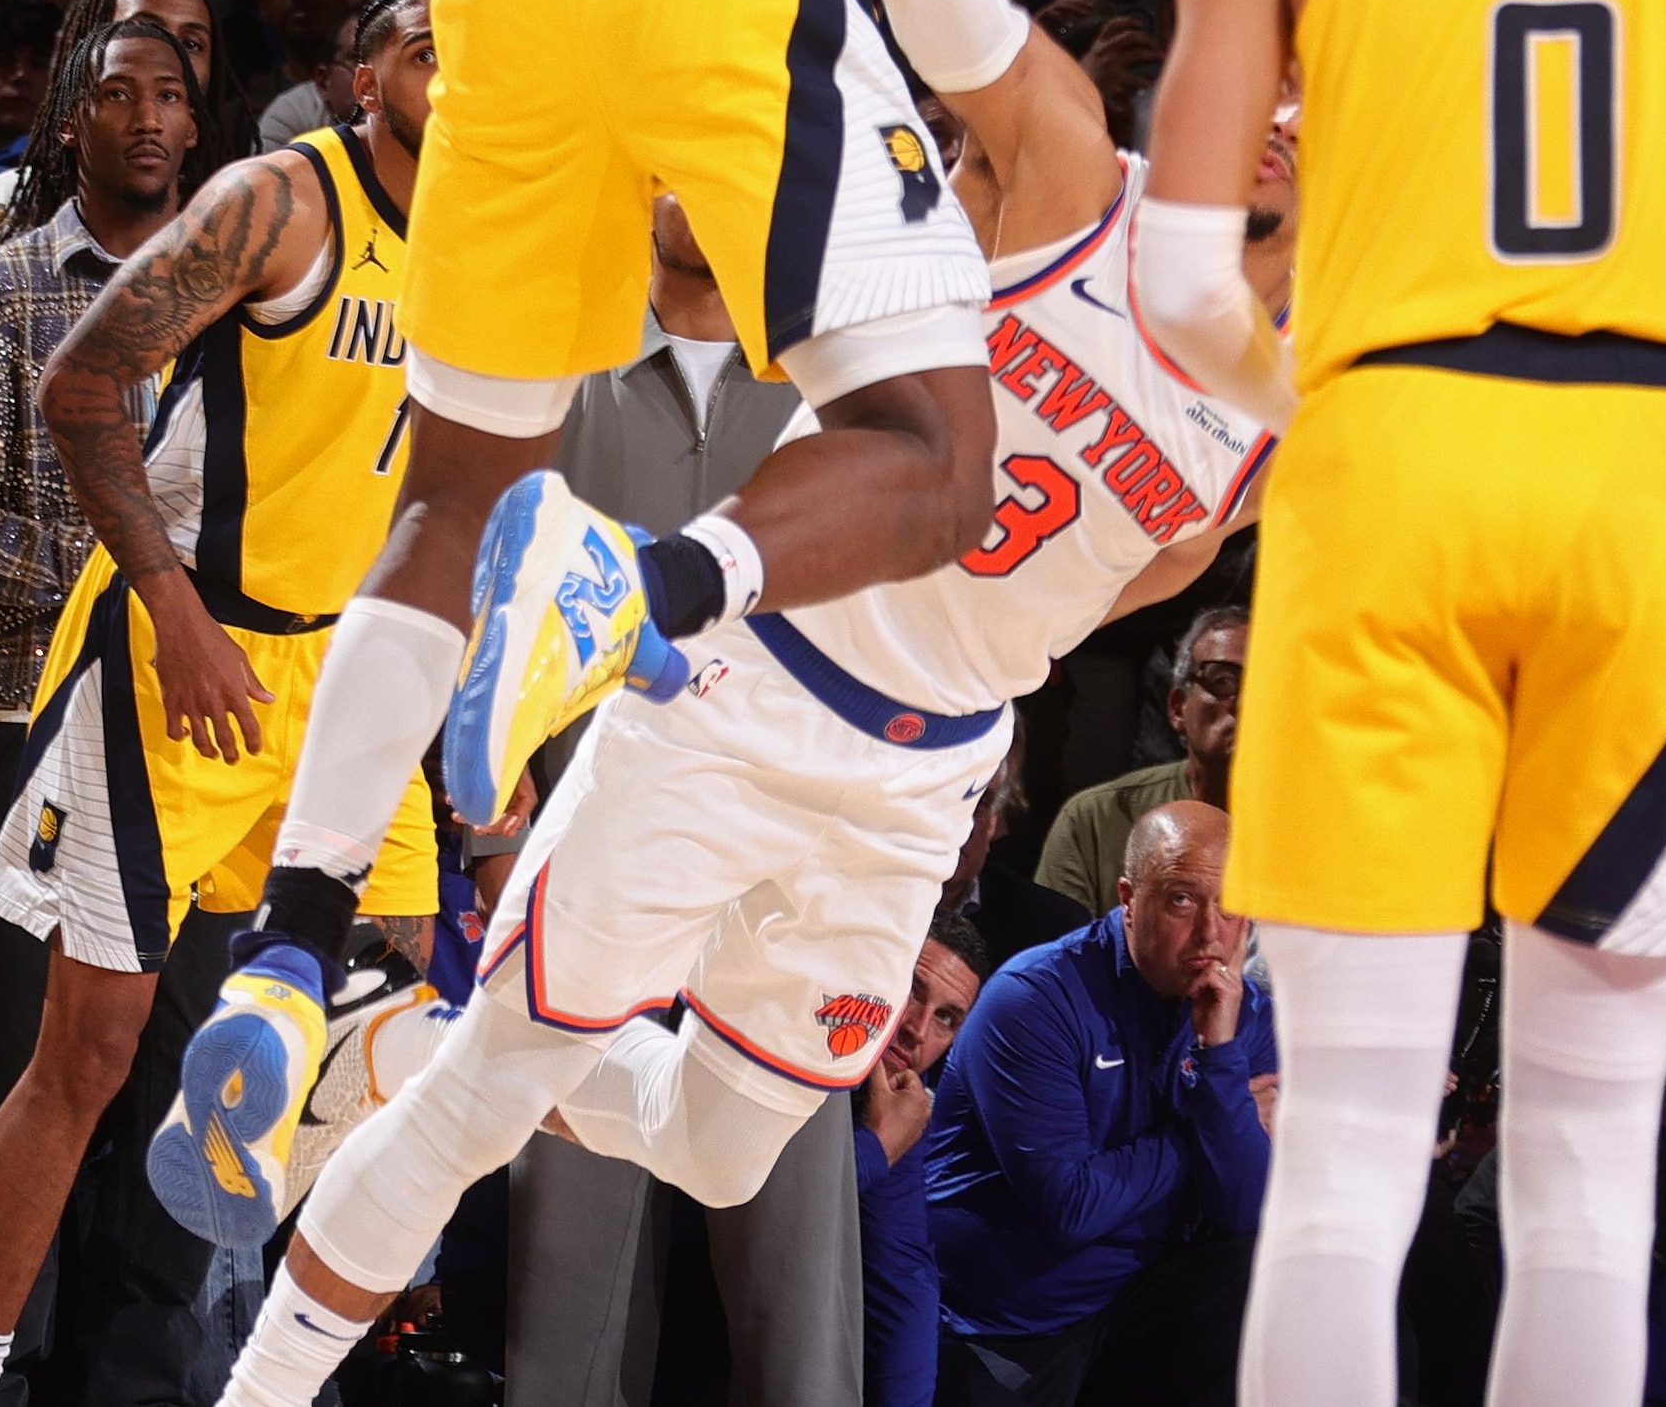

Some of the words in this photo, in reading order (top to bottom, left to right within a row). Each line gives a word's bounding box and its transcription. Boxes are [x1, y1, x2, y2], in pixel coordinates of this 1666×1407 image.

[985, 311, 1113, 435] NEW
[1076, 404, 1211, 546] YORK
[957, 453, 1082, 579] 3
[814, 993, 893, 1031] KNICKS
